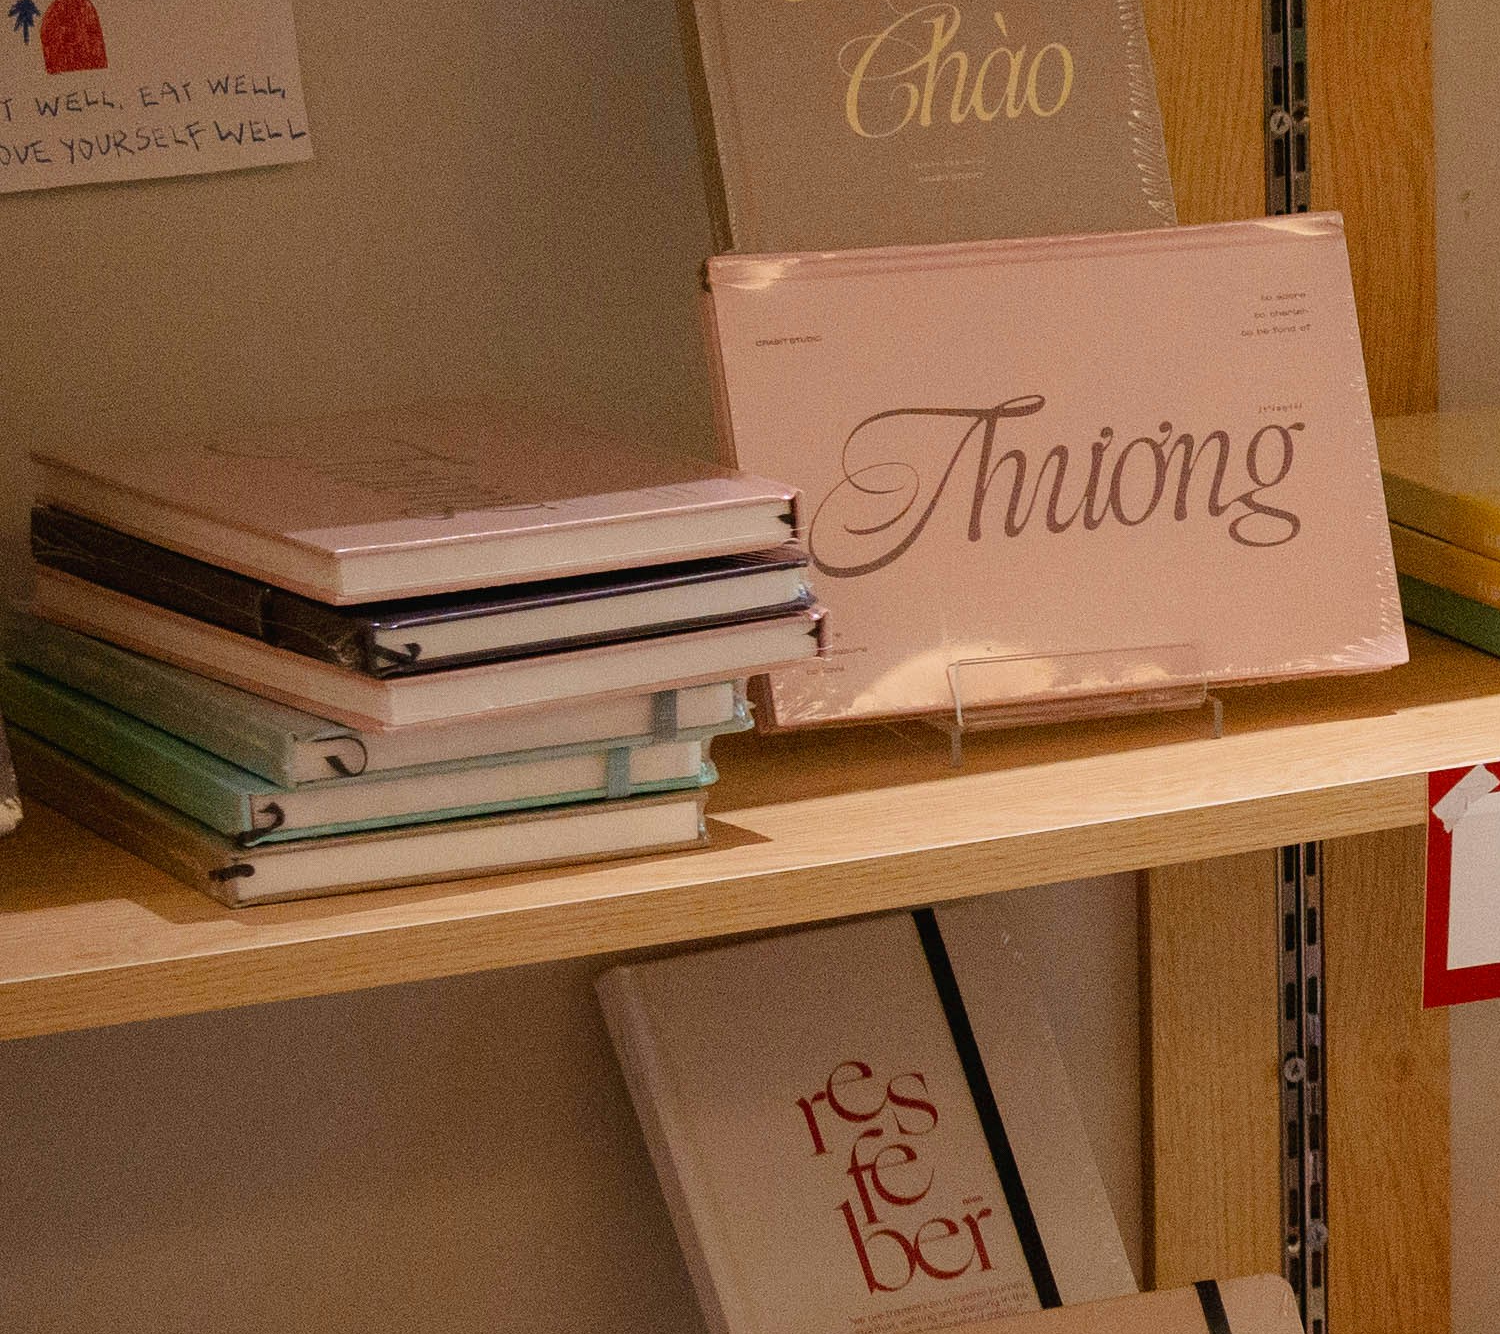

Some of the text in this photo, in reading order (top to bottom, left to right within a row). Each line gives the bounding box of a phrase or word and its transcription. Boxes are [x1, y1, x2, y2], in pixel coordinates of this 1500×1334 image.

[139, 80, 193, 110] EAT
[836, 2, 1075, 139] Chào
[59, 116, 308, 160] YOURSELF WELL
[807, 393, 1307, 579] Thương
[795, 1059, 939, 1158] res
[833, 1198, 997, 1296] ber
